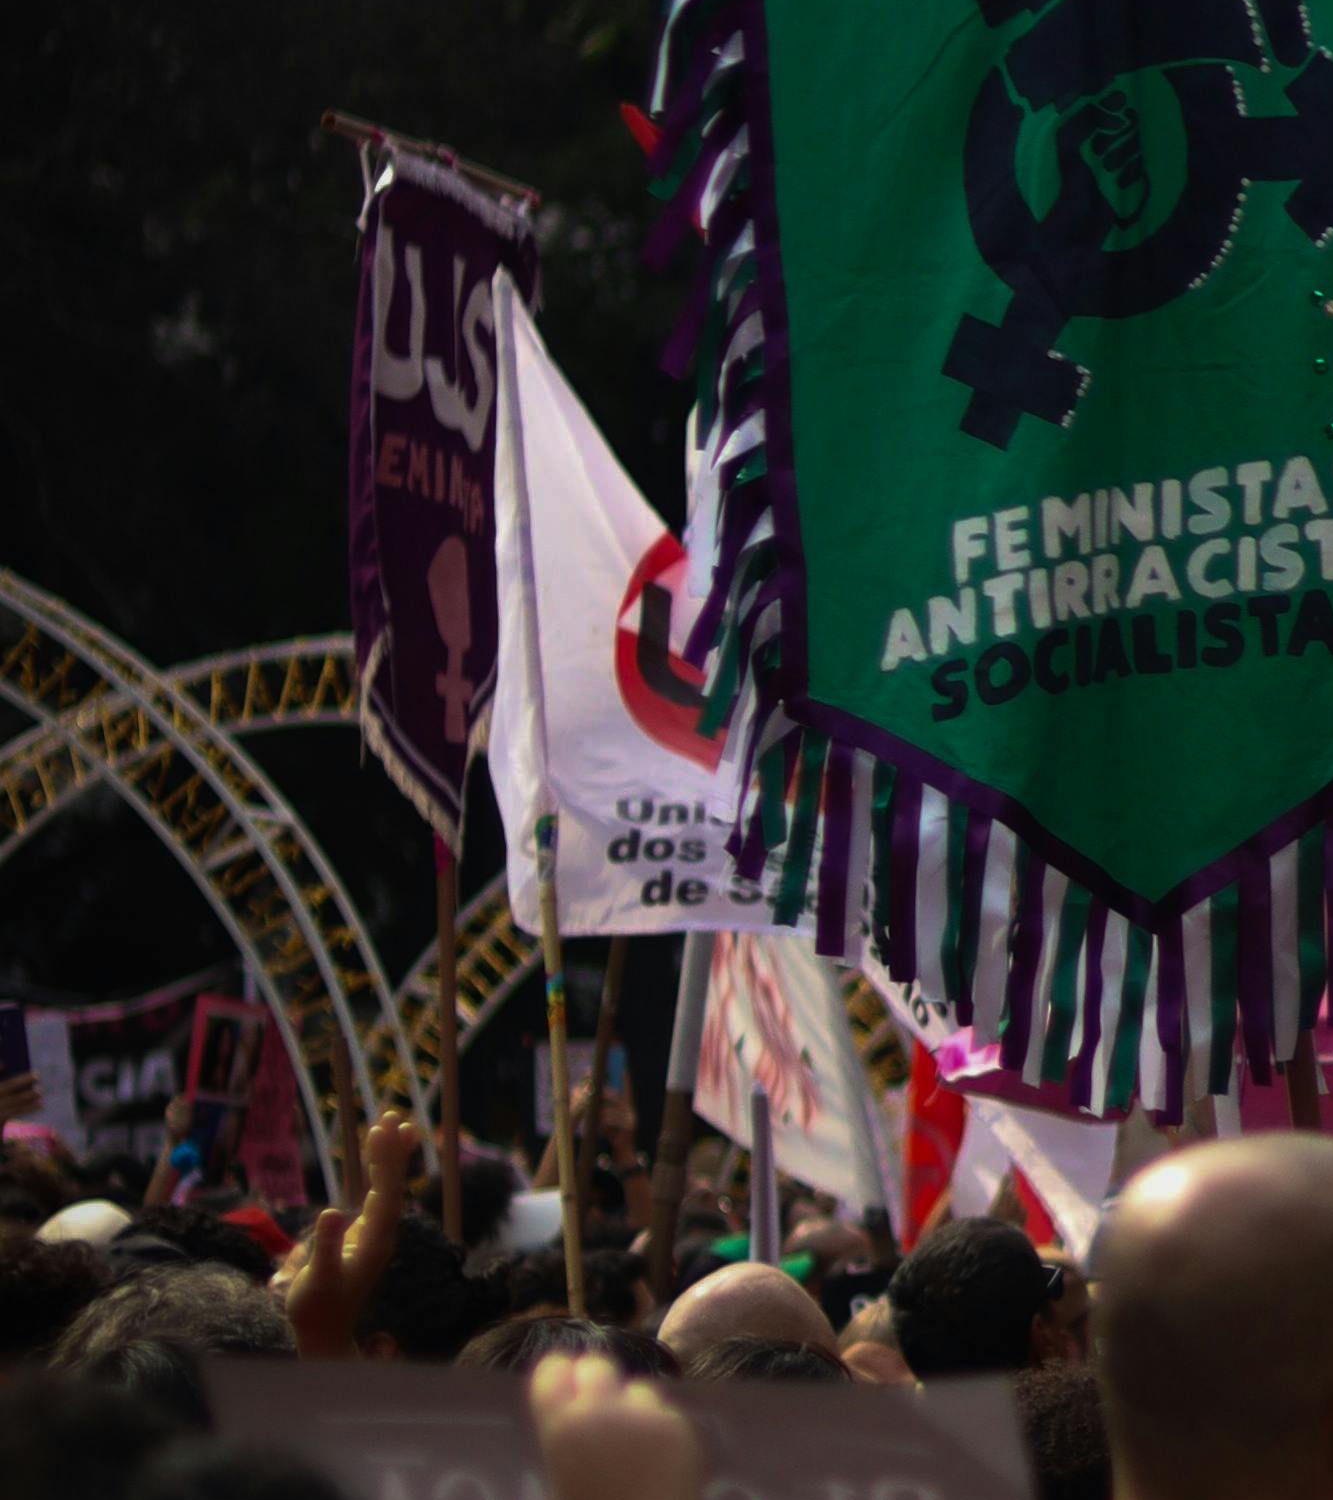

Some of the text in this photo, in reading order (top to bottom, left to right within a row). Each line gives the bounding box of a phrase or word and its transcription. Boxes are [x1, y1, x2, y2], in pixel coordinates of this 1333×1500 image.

[615, 797, 735, 827] Uni
[606, 829, 707, 865] dos
[640, 870, 709, 908] de
